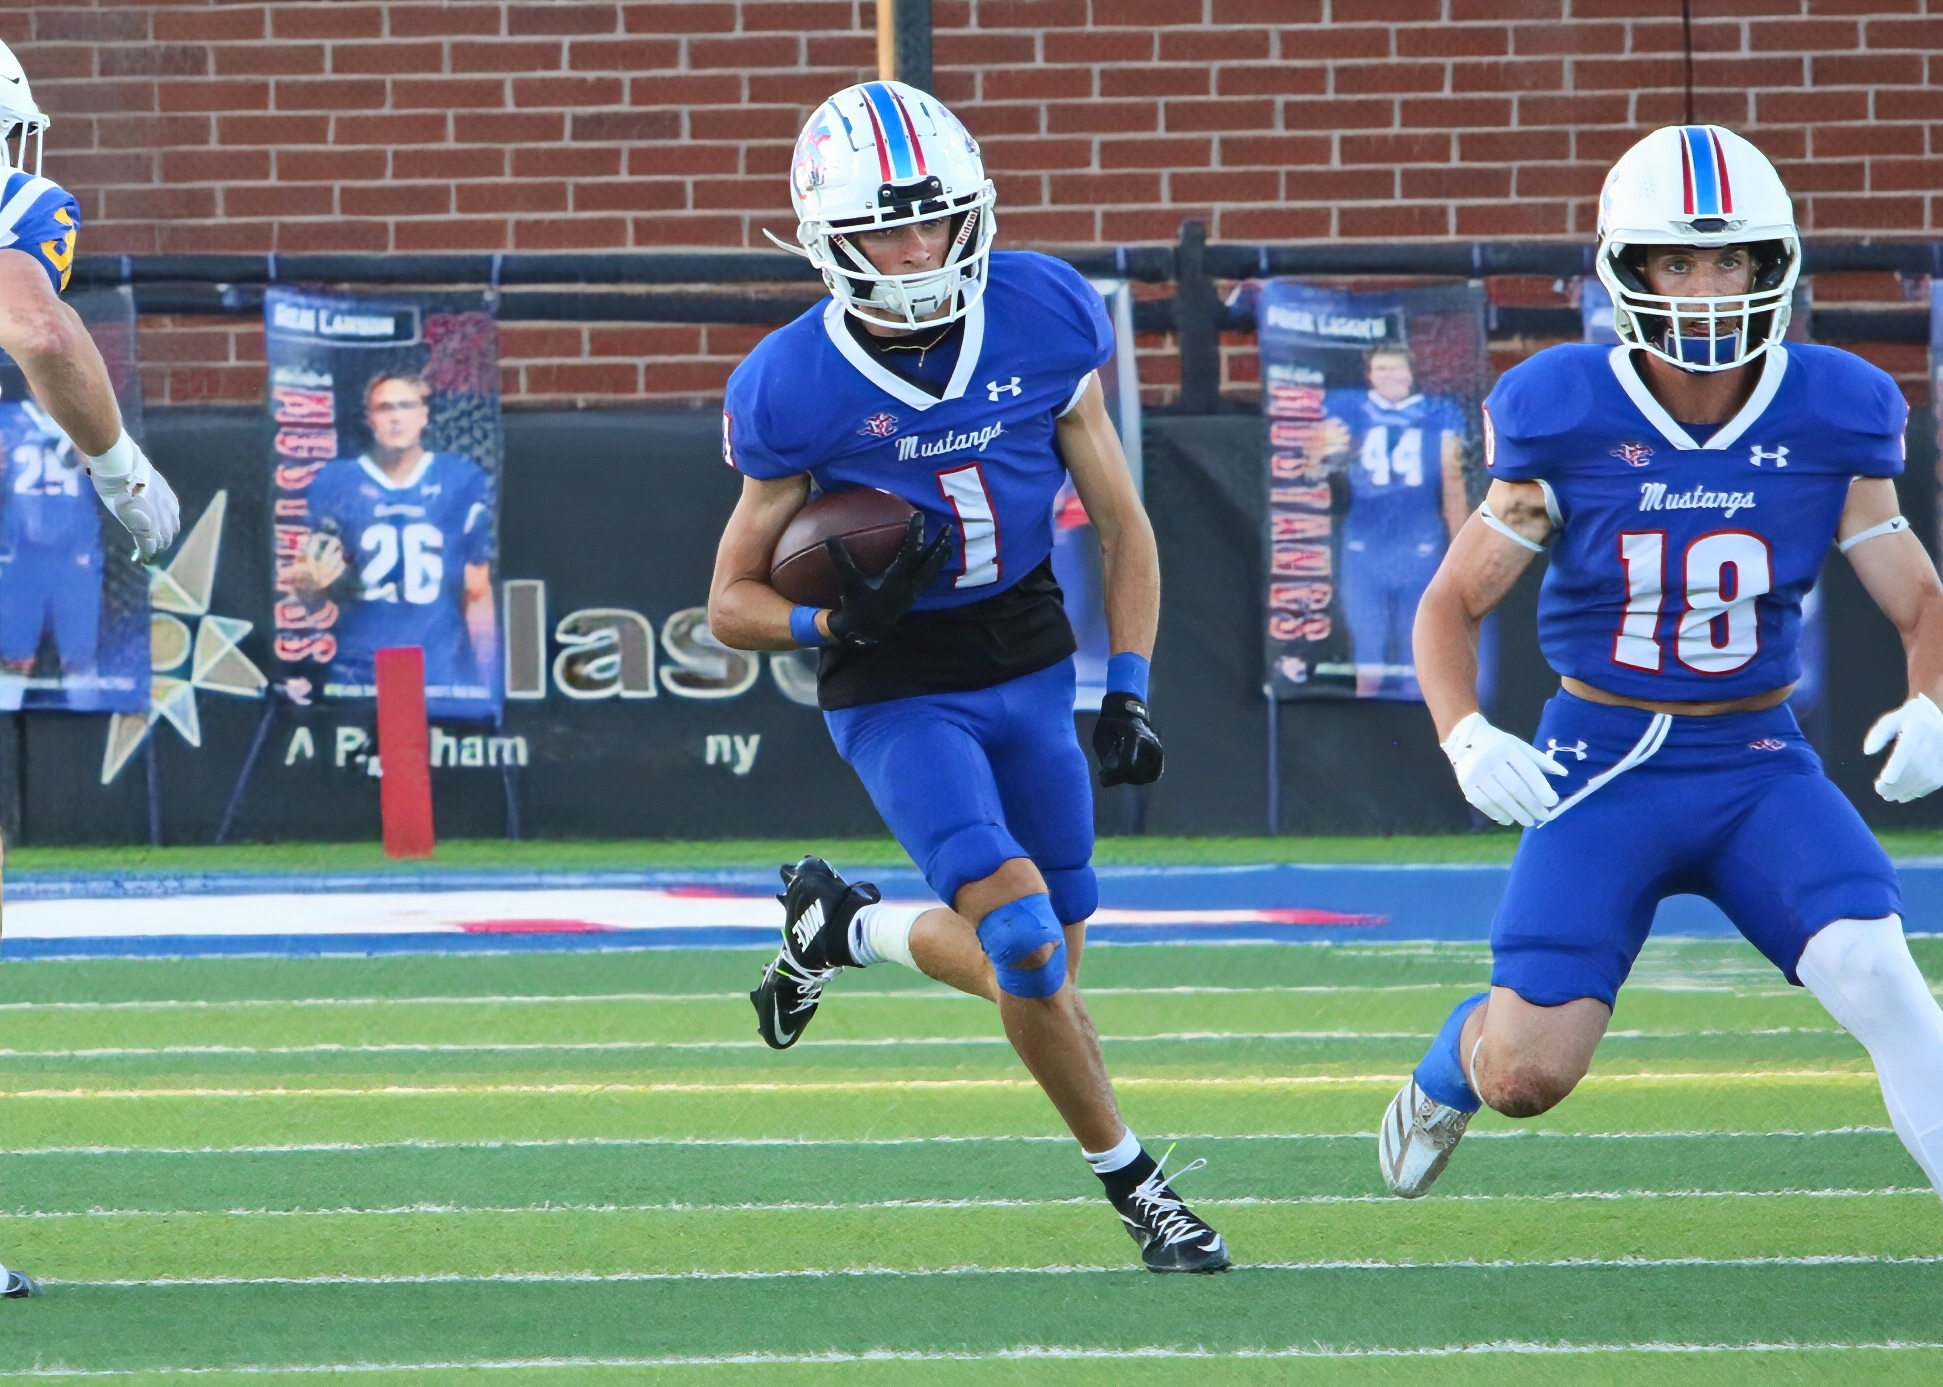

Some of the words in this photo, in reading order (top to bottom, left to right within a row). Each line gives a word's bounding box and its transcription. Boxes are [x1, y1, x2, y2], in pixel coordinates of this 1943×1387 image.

[895, 421, 1006, 461] Mustangs
[1360, 425, 1423, 487] 44
[935, 462, 1003, 589] 1
[1638, 482, 1756, 519] Mustangs
[360, 523, 444, 604] 26
[1611, 528, 1774, 676] 18
[791, 898, 826, 953] NIKE
